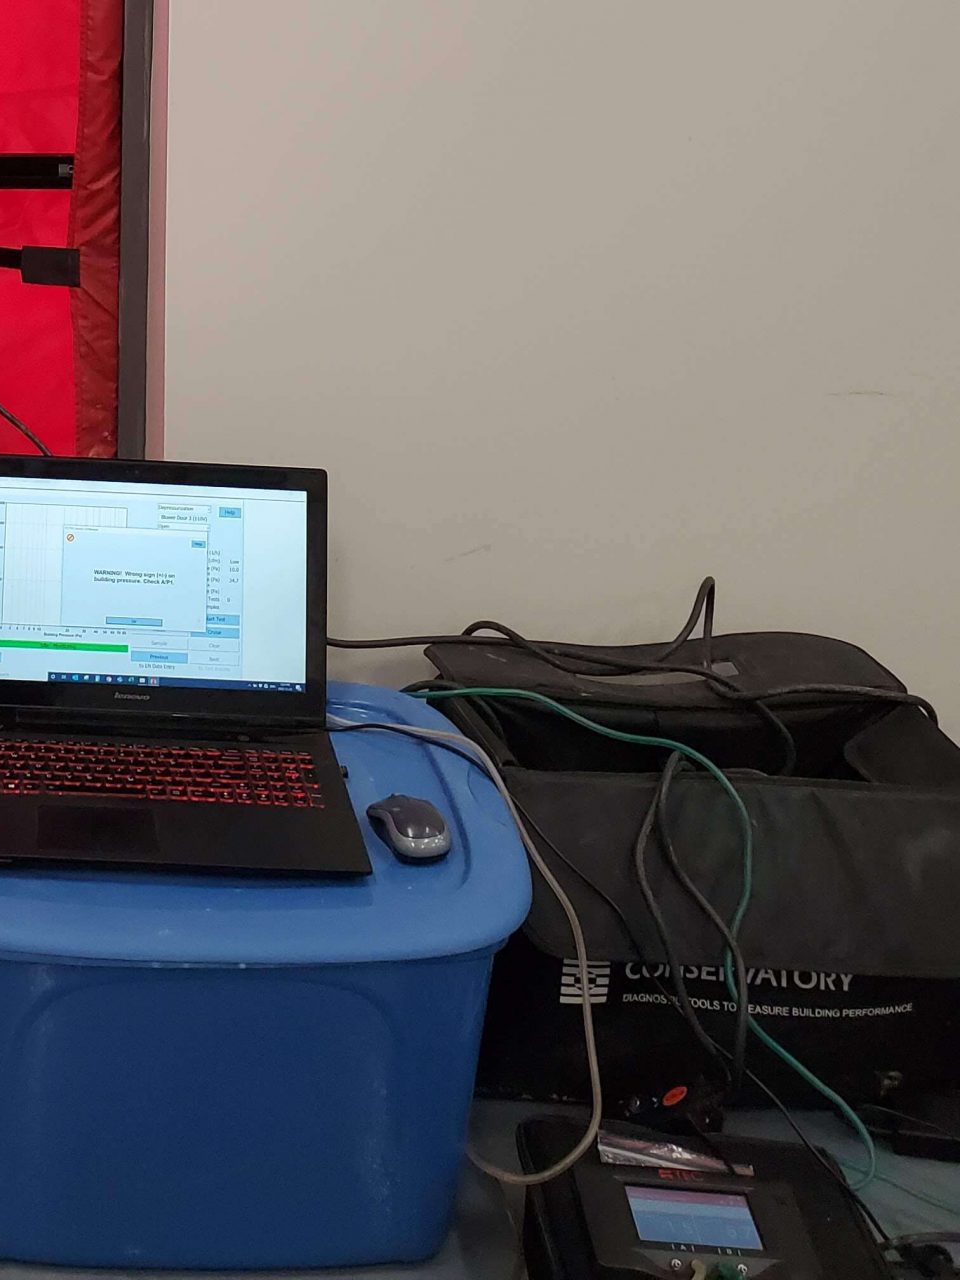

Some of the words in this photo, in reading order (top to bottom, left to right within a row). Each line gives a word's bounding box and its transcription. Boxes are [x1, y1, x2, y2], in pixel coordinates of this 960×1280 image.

[124, 570, 143, 578] Wrong
[625, 961, 853, 992] CONSEATORY
[688, 997, 721, 1012] OOLS
[722, 1001, 738, 1013] TO
[746, 1003, 790, 1017] EASURE
[791, 1006, 841, 1018] BUILDING
[842, 1002, 913, 1018] PERFORMANCE
